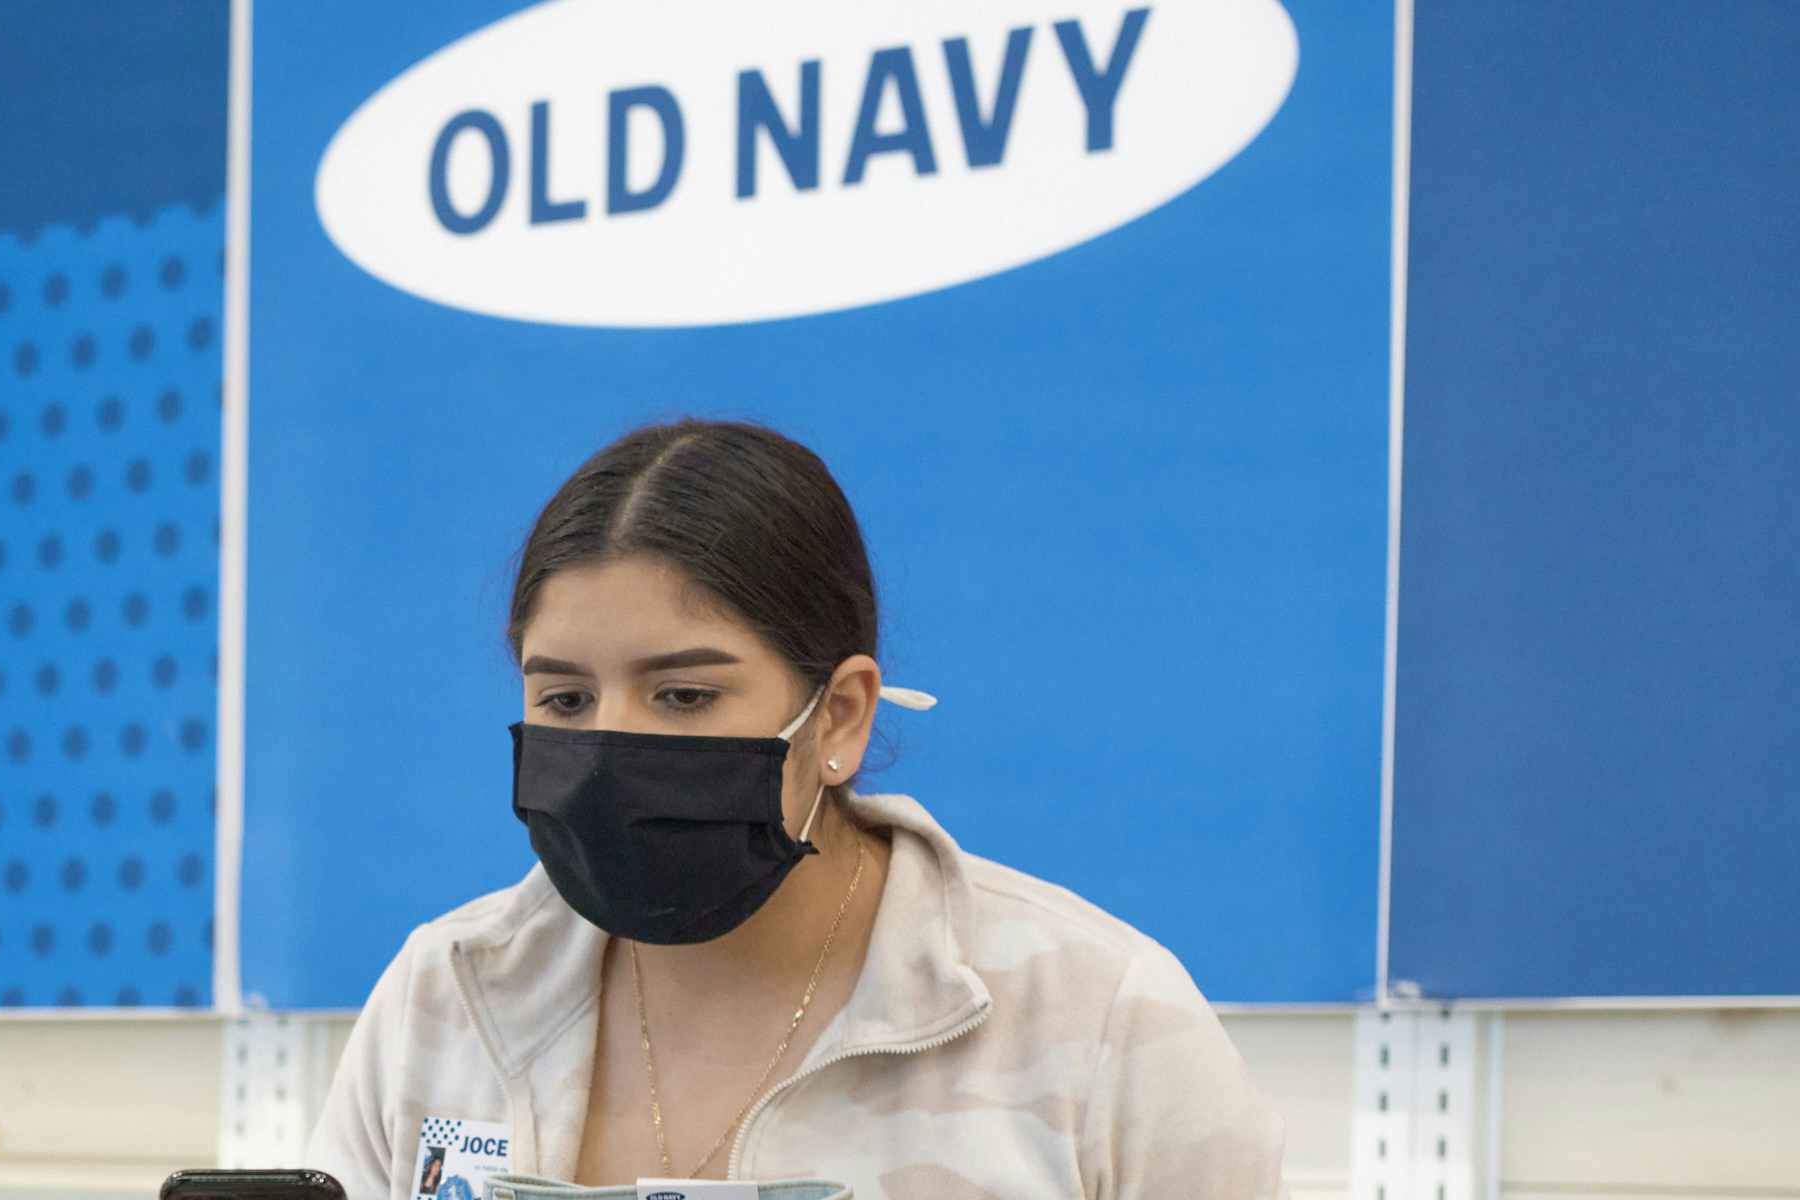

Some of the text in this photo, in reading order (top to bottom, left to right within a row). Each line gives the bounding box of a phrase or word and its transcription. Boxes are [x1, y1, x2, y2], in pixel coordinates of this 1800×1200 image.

[428, 7, 1152, 235] OLD NAVY
[460, 1136, 509, 1157] JOCE
